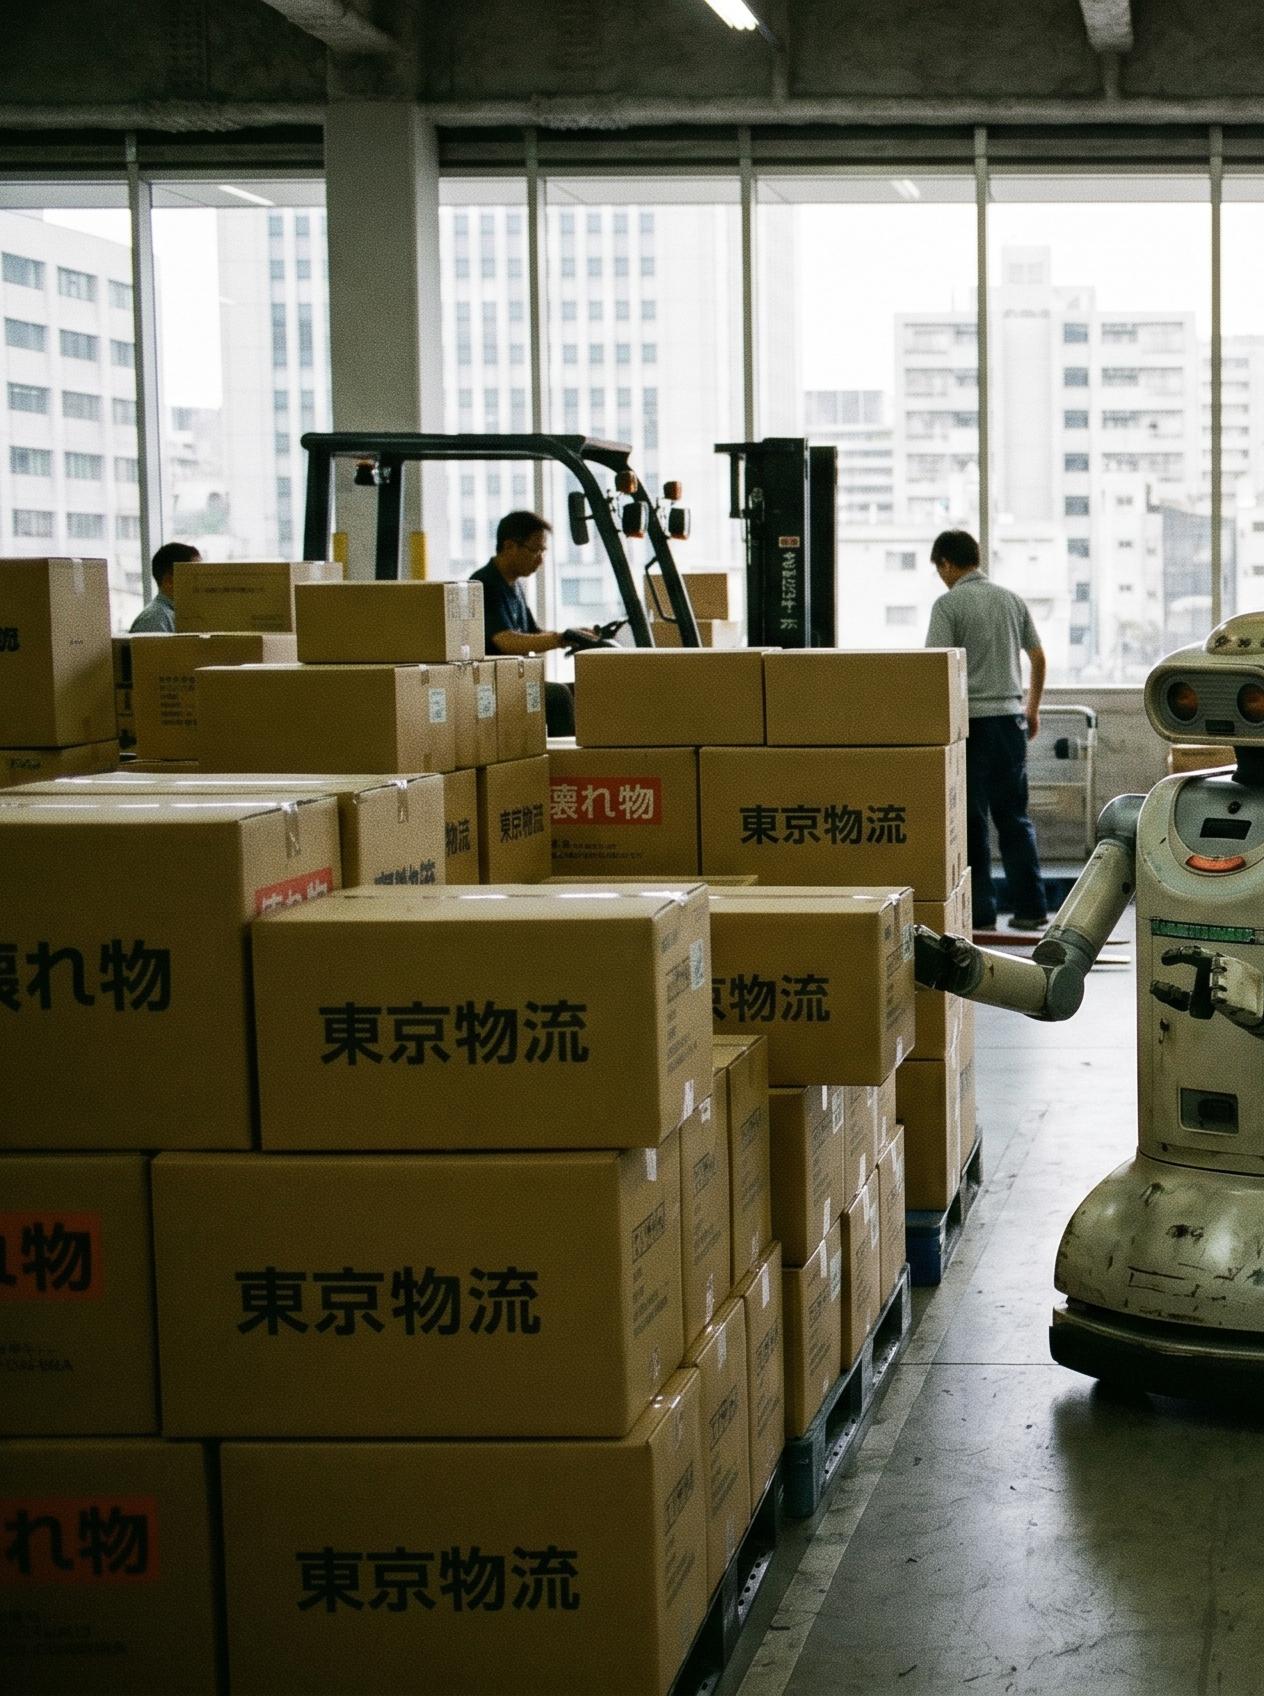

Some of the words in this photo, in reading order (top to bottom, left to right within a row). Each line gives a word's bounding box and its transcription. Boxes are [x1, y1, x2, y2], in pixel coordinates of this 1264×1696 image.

[739, 804, 907, 845] 東京物流
[318, 1001, 589, 1066] 東京物流
[0, 1222, 91, 1292] 物
[234, 1266, 541, 1336] 東京物流
[295, 1546, 581, 1613] 東京物流
